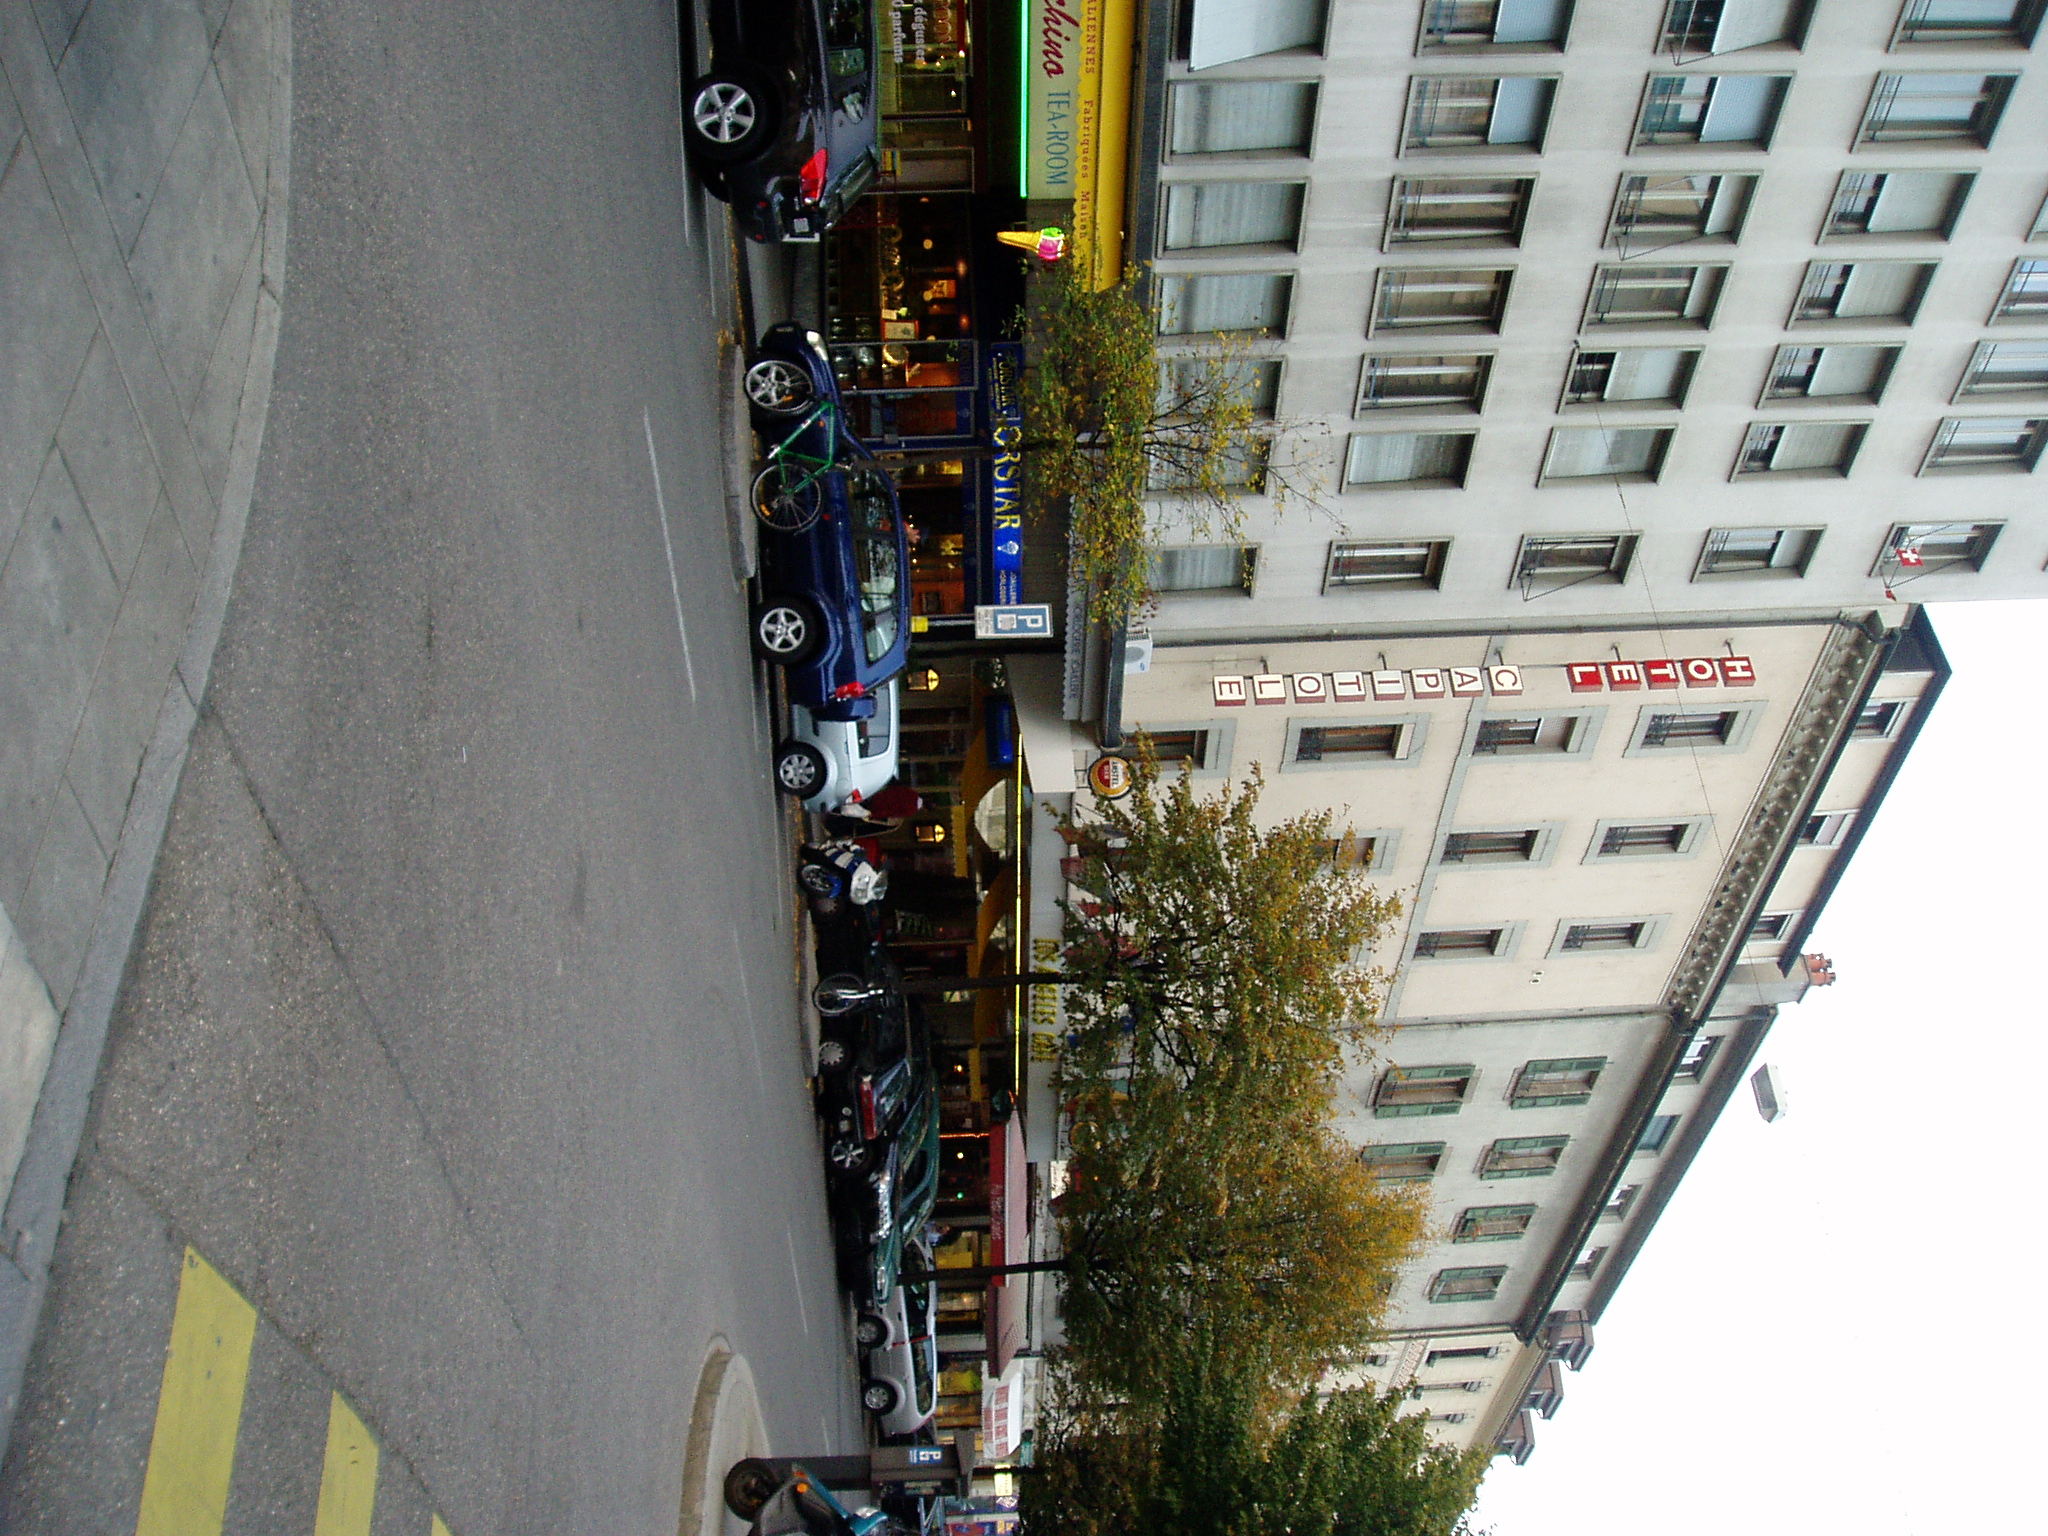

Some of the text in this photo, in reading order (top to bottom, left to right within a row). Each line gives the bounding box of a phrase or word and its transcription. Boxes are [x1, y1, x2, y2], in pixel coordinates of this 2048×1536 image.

[1045, 90, 1071, 185] TEA-ROOM
[1218, 660, 1752, 696] HOTEL CAPITOLE
